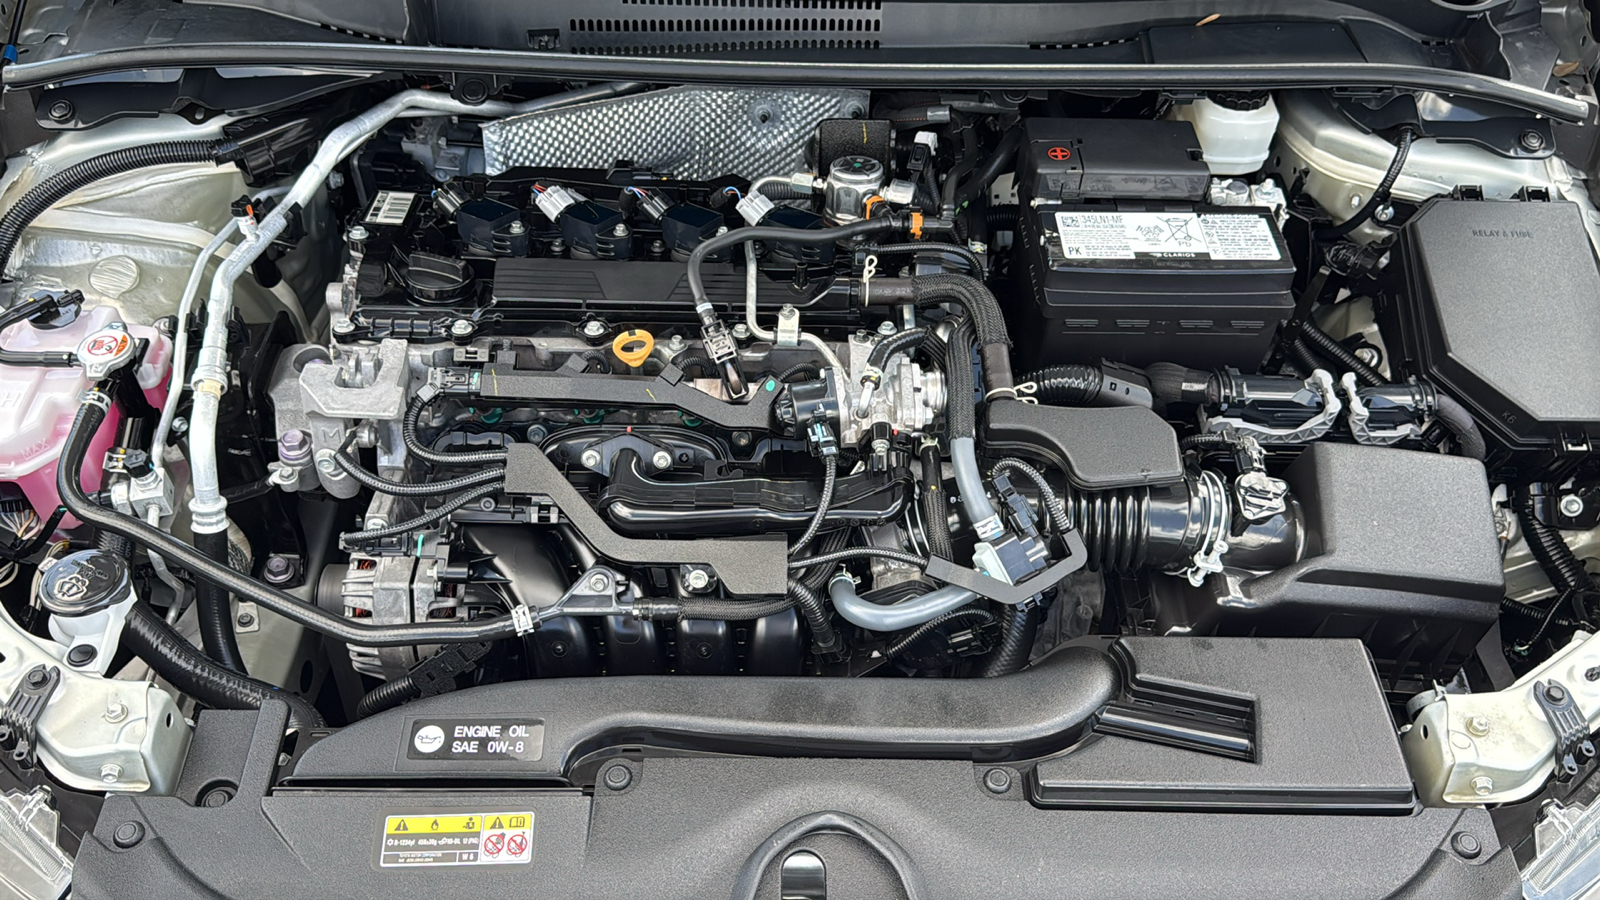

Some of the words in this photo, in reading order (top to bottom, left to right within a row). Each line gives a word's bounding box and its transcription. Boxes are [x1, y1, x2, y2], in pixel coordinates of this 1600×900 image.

[1081, 215, 1123, 224] 345LN1-MF
[1068, 246, 1082, 255] PK
[1502, 411, 1516, 423] K6
[21, 437, 50, 459] MAX
[454, 725, 501, 738] ENGINE
[508, 725, 530, 737] OIL
[452, 741, 479, 753] SAE
[487, 741, 524, 753] 0W-8
